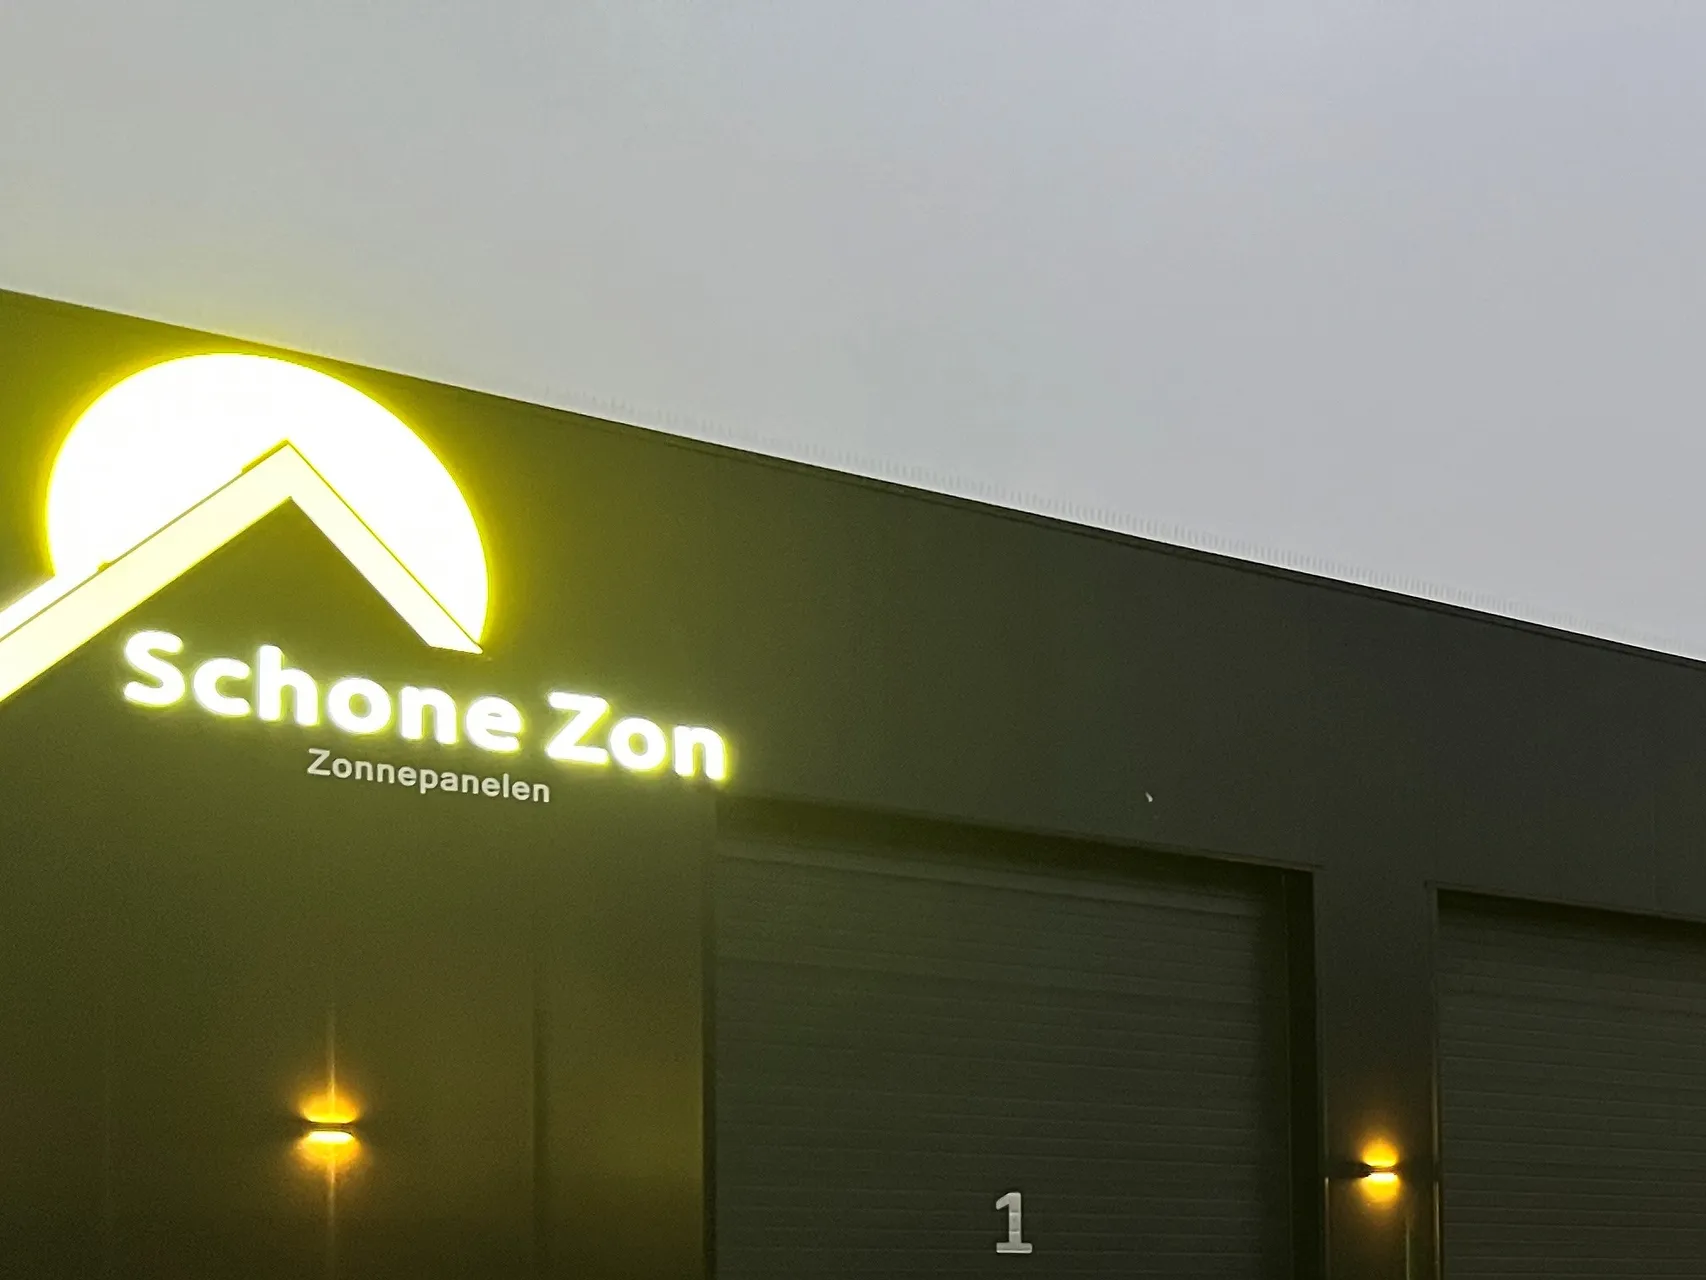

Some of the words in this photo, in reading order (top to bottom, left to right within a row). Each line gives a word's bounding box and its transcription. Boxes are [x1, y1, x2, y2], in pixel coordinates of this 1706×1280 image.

[123, 629, 524, 753] Schone
[546, 691, 729, 781] Zon
[307, 748, 551, 803] Zonnepanelen
[995, 1192, 1033, 1254] 1
